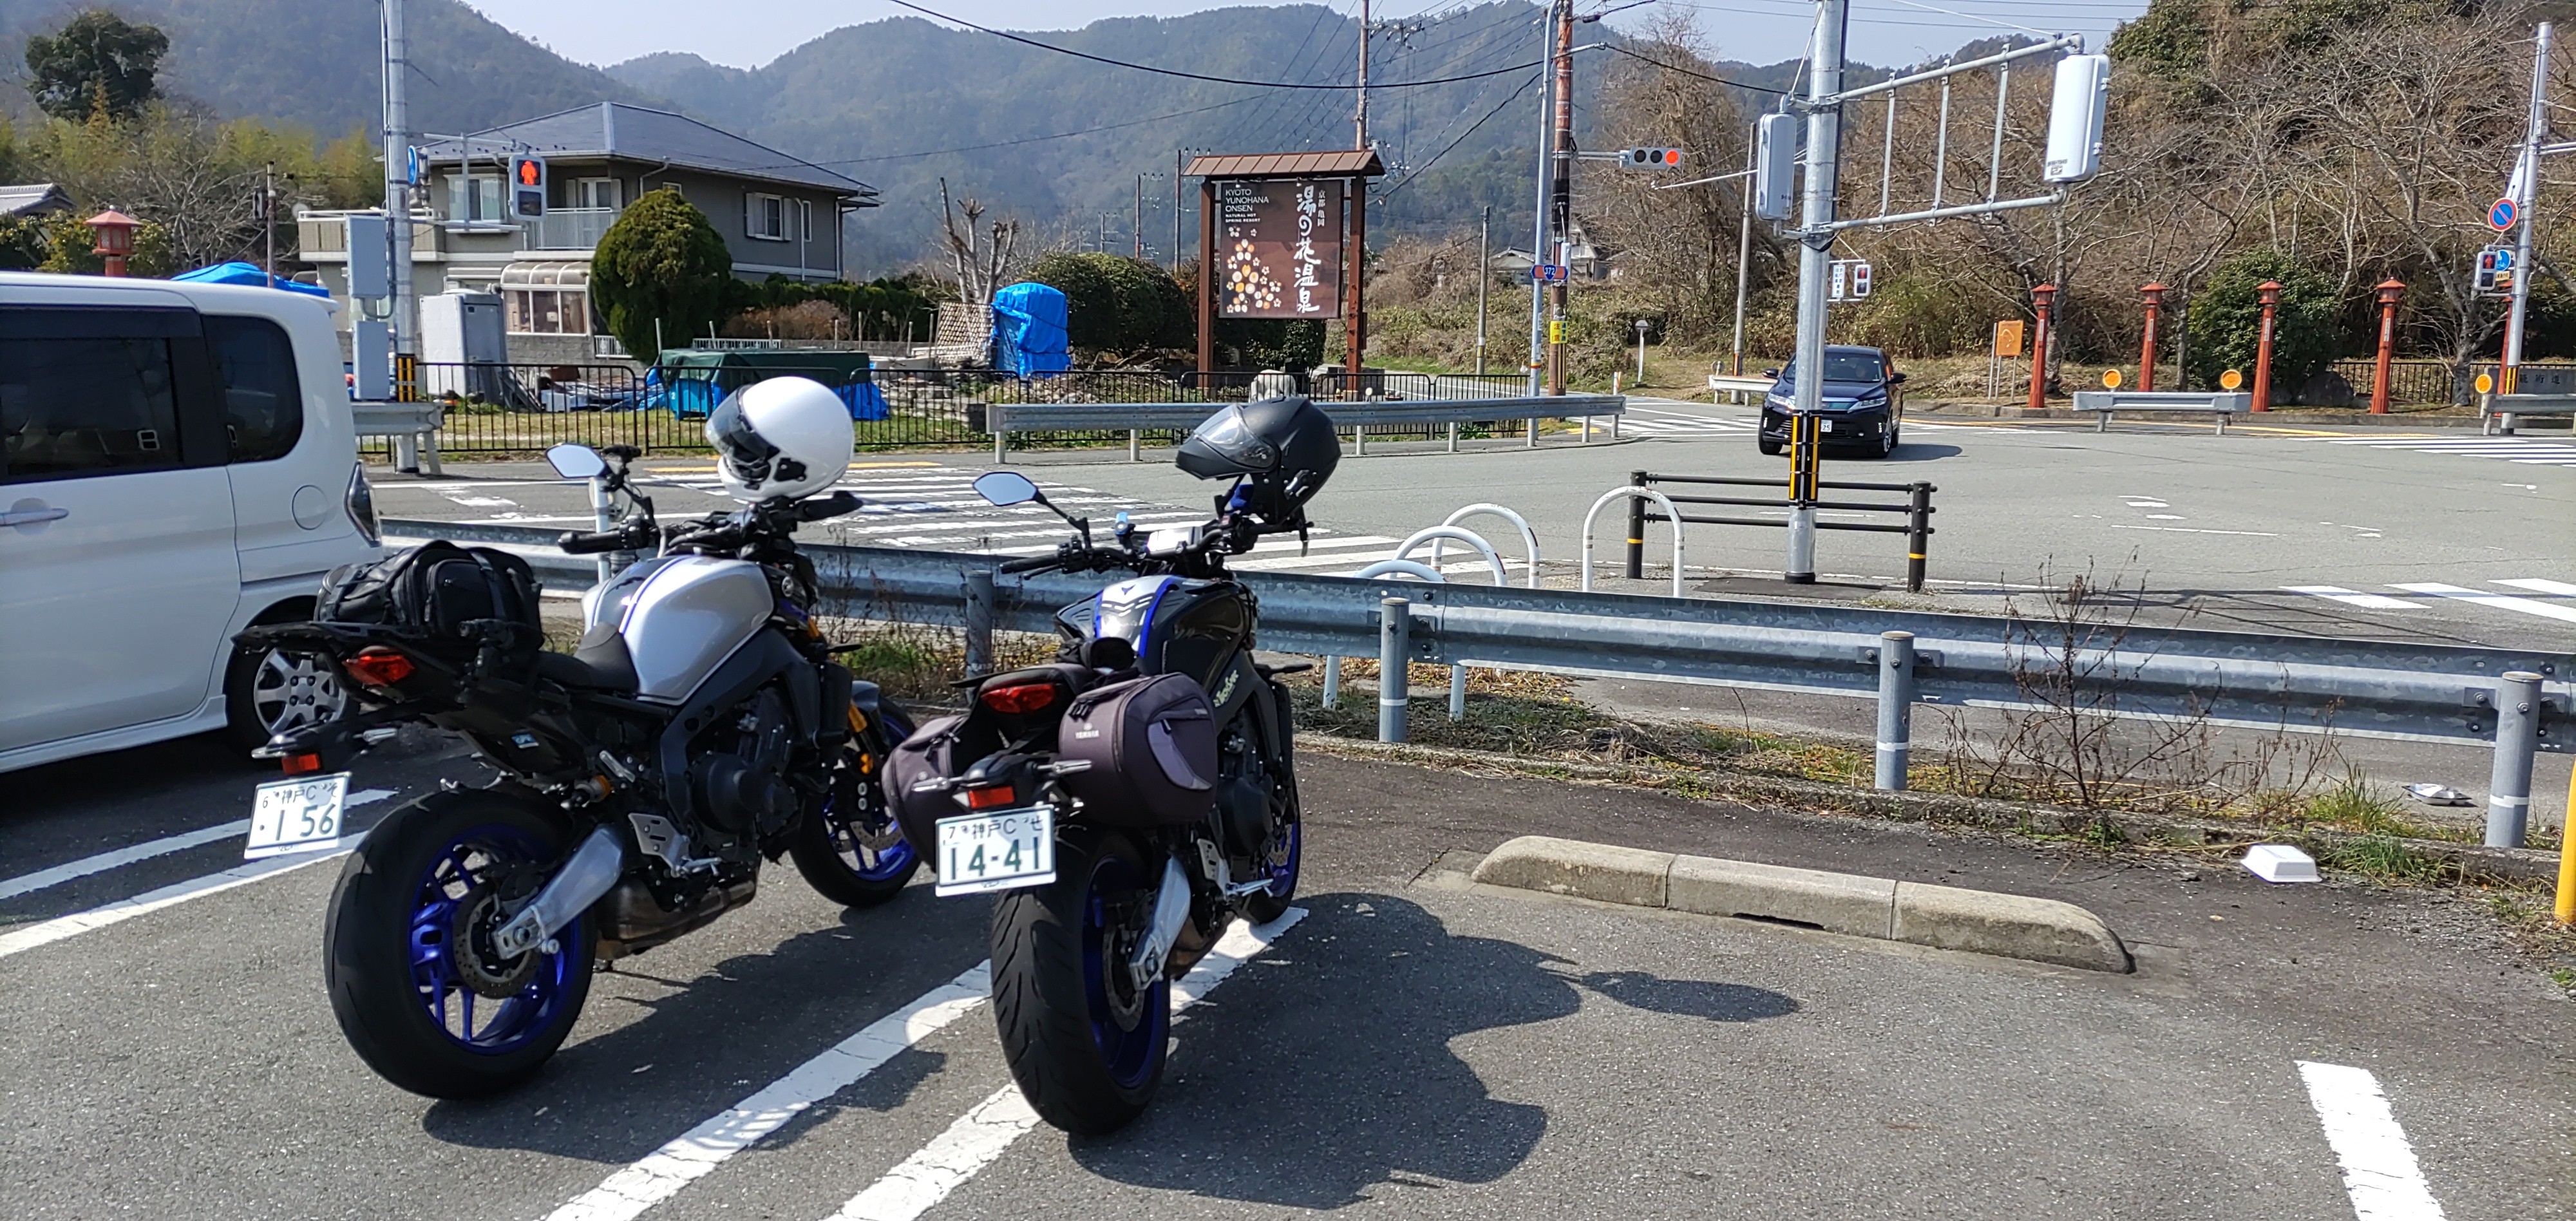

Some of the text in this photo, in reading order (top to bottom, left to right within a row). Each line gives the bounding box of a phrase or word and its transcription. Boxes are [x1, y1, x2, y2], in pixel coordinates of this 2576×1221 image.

[1294, 185, 1321, 313] 湯の花温泉
[1030, 815, 1043, 831] せ
[951, 837, 1039, 880] 14-41
